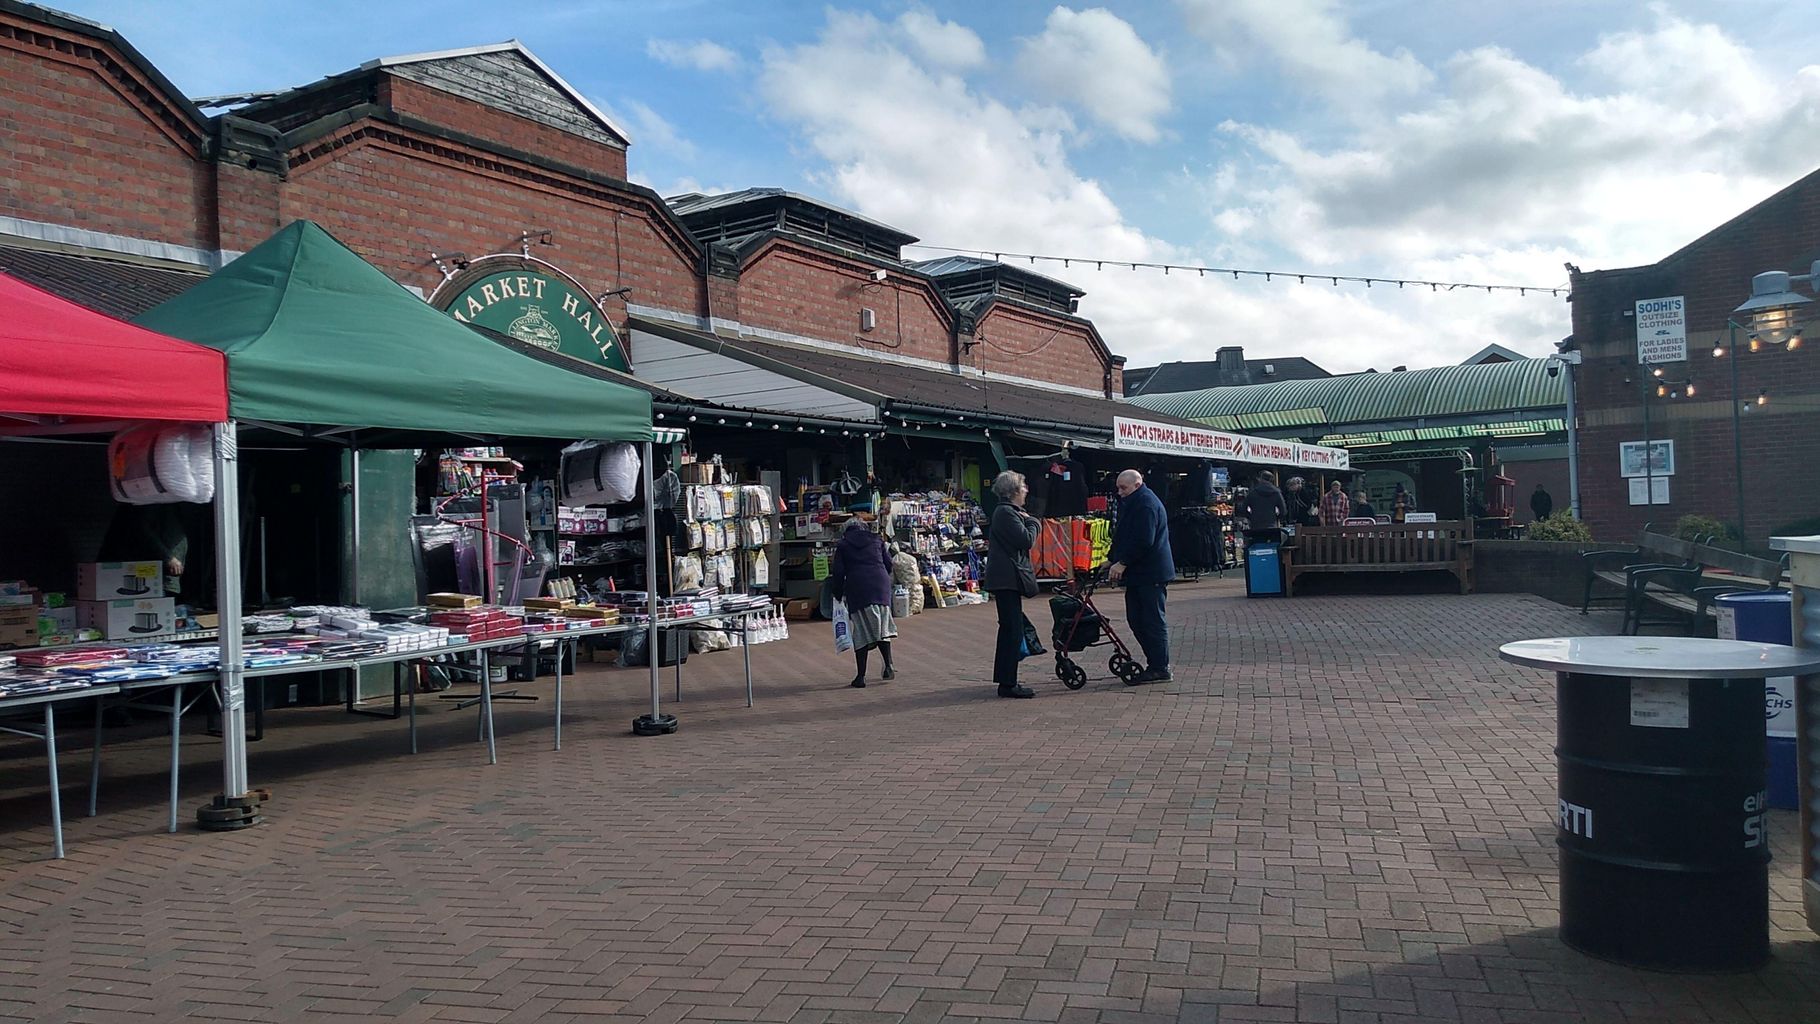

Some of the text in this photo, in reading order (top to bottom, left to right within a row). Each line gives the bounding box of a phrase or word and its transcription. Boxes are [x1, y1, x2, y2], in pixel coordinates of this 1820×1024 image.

[1638, 300, 1681, 314] SODHI'S
[1641, 311, 1679, 321] OUTSIZE
[562, 292, 613, 360] HALL
[1638, 318, 1683, 329] CLOTHING
[1639, 337, 1685, 348] FOR LADIES
[1642, 344, 1683, 355] AND MENS
[1118, 422, 1233, 451] WATCH STRAPS & BATTERIES FITTED
[1250, 443, 1270, 459] WATCH
[1271, 445, 1292, 460] REPAIRS
[1301, 449, 1311, 462] KEY
[1311, 450, 1330, 465] CUTTING
[1766, 699, 1793, 709] CHS
[1559, 798, 1593, 839] RTI
